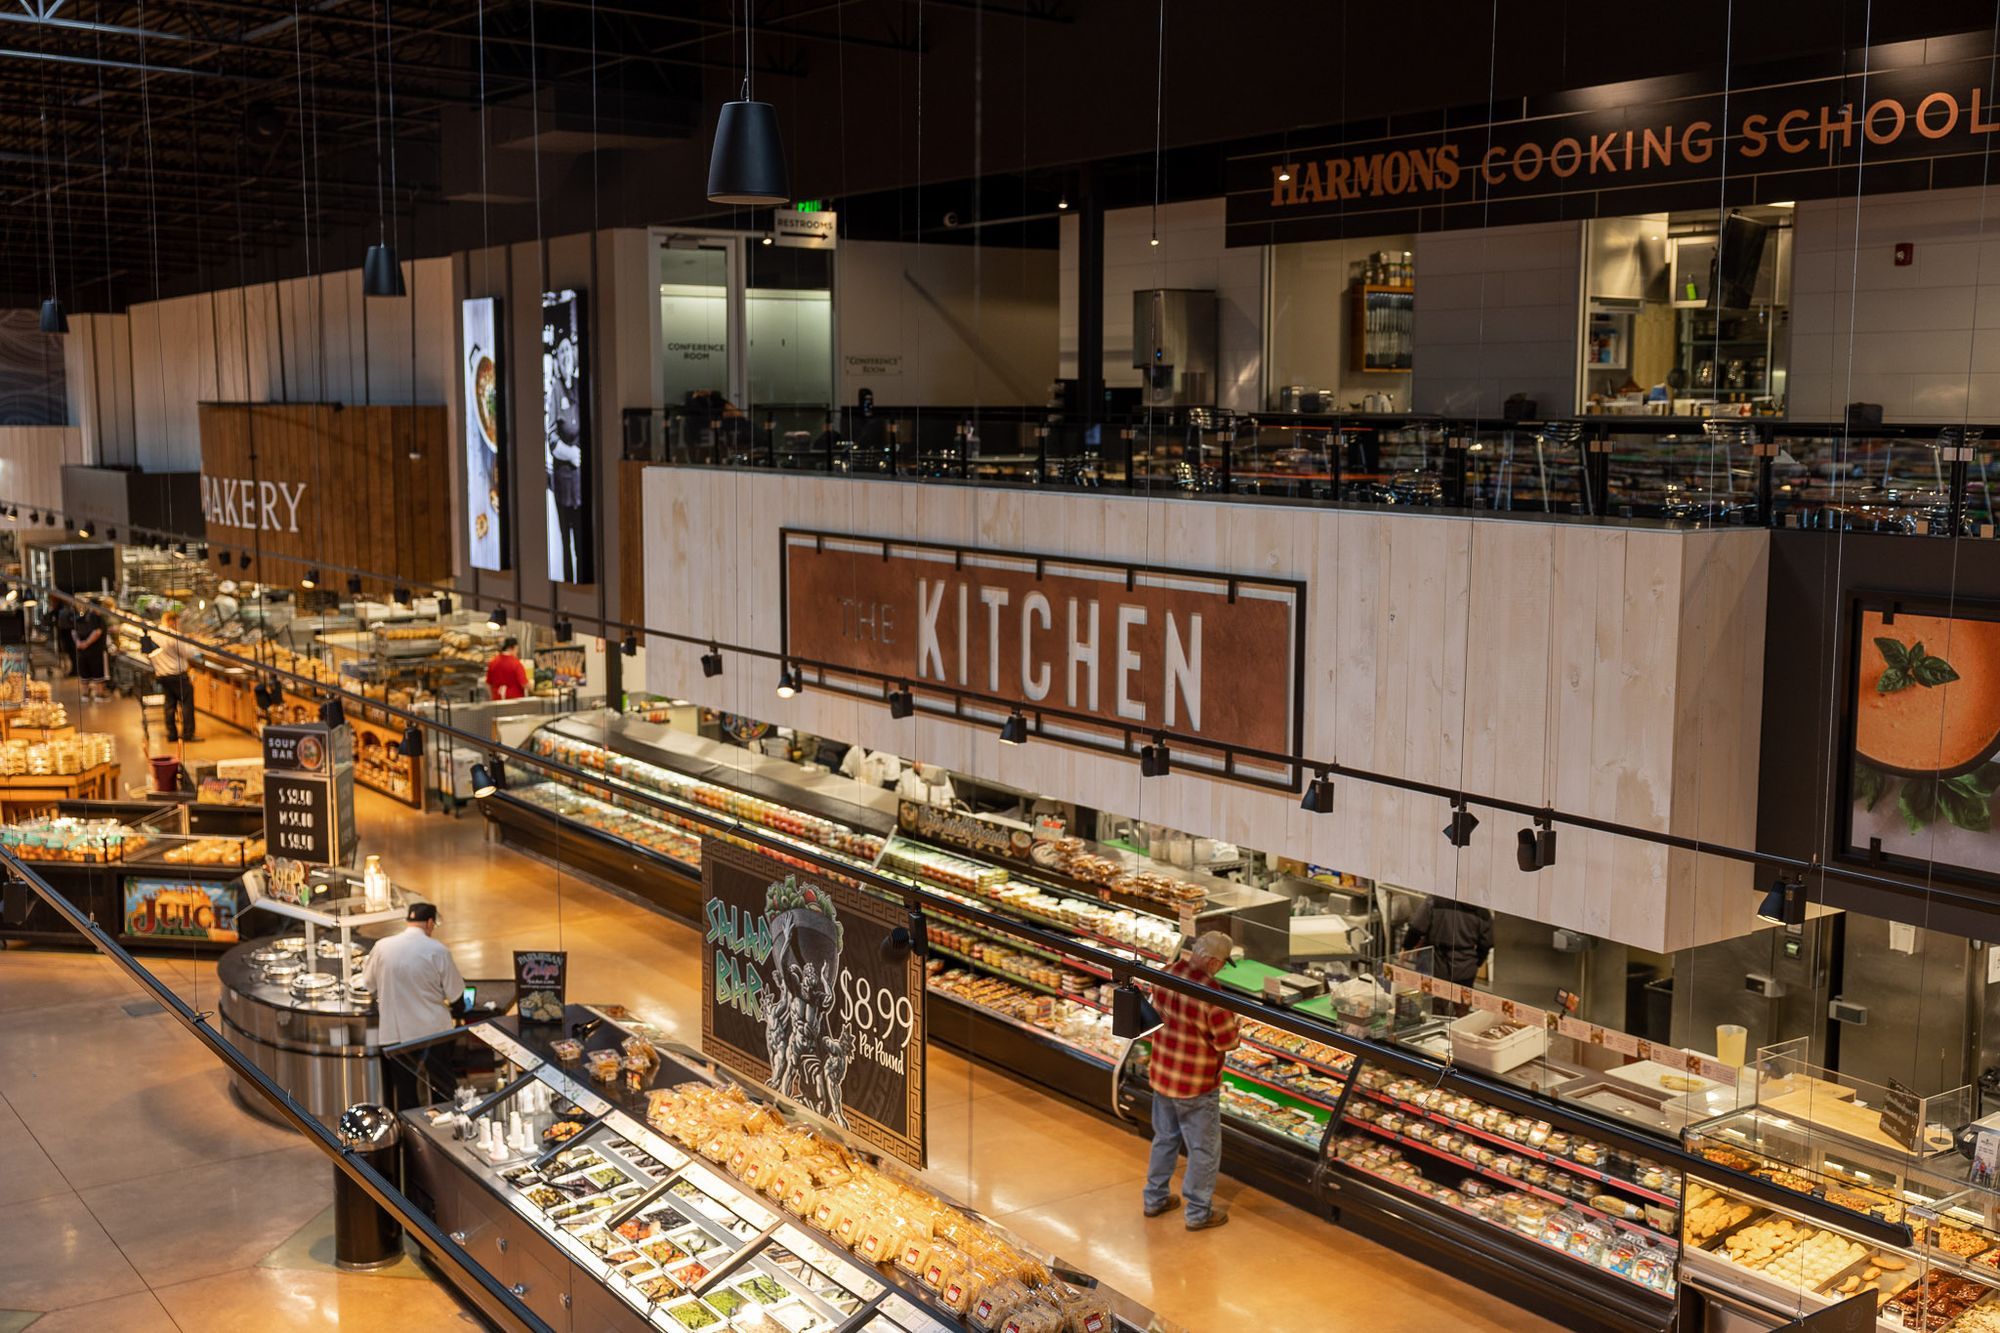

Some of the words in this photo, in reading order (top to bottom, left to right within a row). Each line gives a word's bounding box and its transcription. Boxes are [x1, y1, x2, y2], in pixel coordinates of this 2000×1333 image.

[1271, 144, 1459, 206] HARMONS
[1482, 121, 1713, 185] COOKING
[1739, 88, 2000, 157] SCHOOL
[777, 218, 833, 230] RESTROOMS
[667, 342, 725, 352] CONFERENCE
[683, 352, 710, 360] ROOM
[840, 598, 897, 645] THE
[916, 577, 1203, 732] KITCHEN
[268, 738, 296, 749] SOUP
[271, 749, 294, 760] BAR
[133, 894, 234, 935] JUICE
[706, 896, 774, 966] SALAD
[715, 949, 765, 1023] BAR
[840, 966, 914, 1048] $8.99
[859, 1030, 875, 1061] Per
[874, 1036, 905, 1076] Pound
